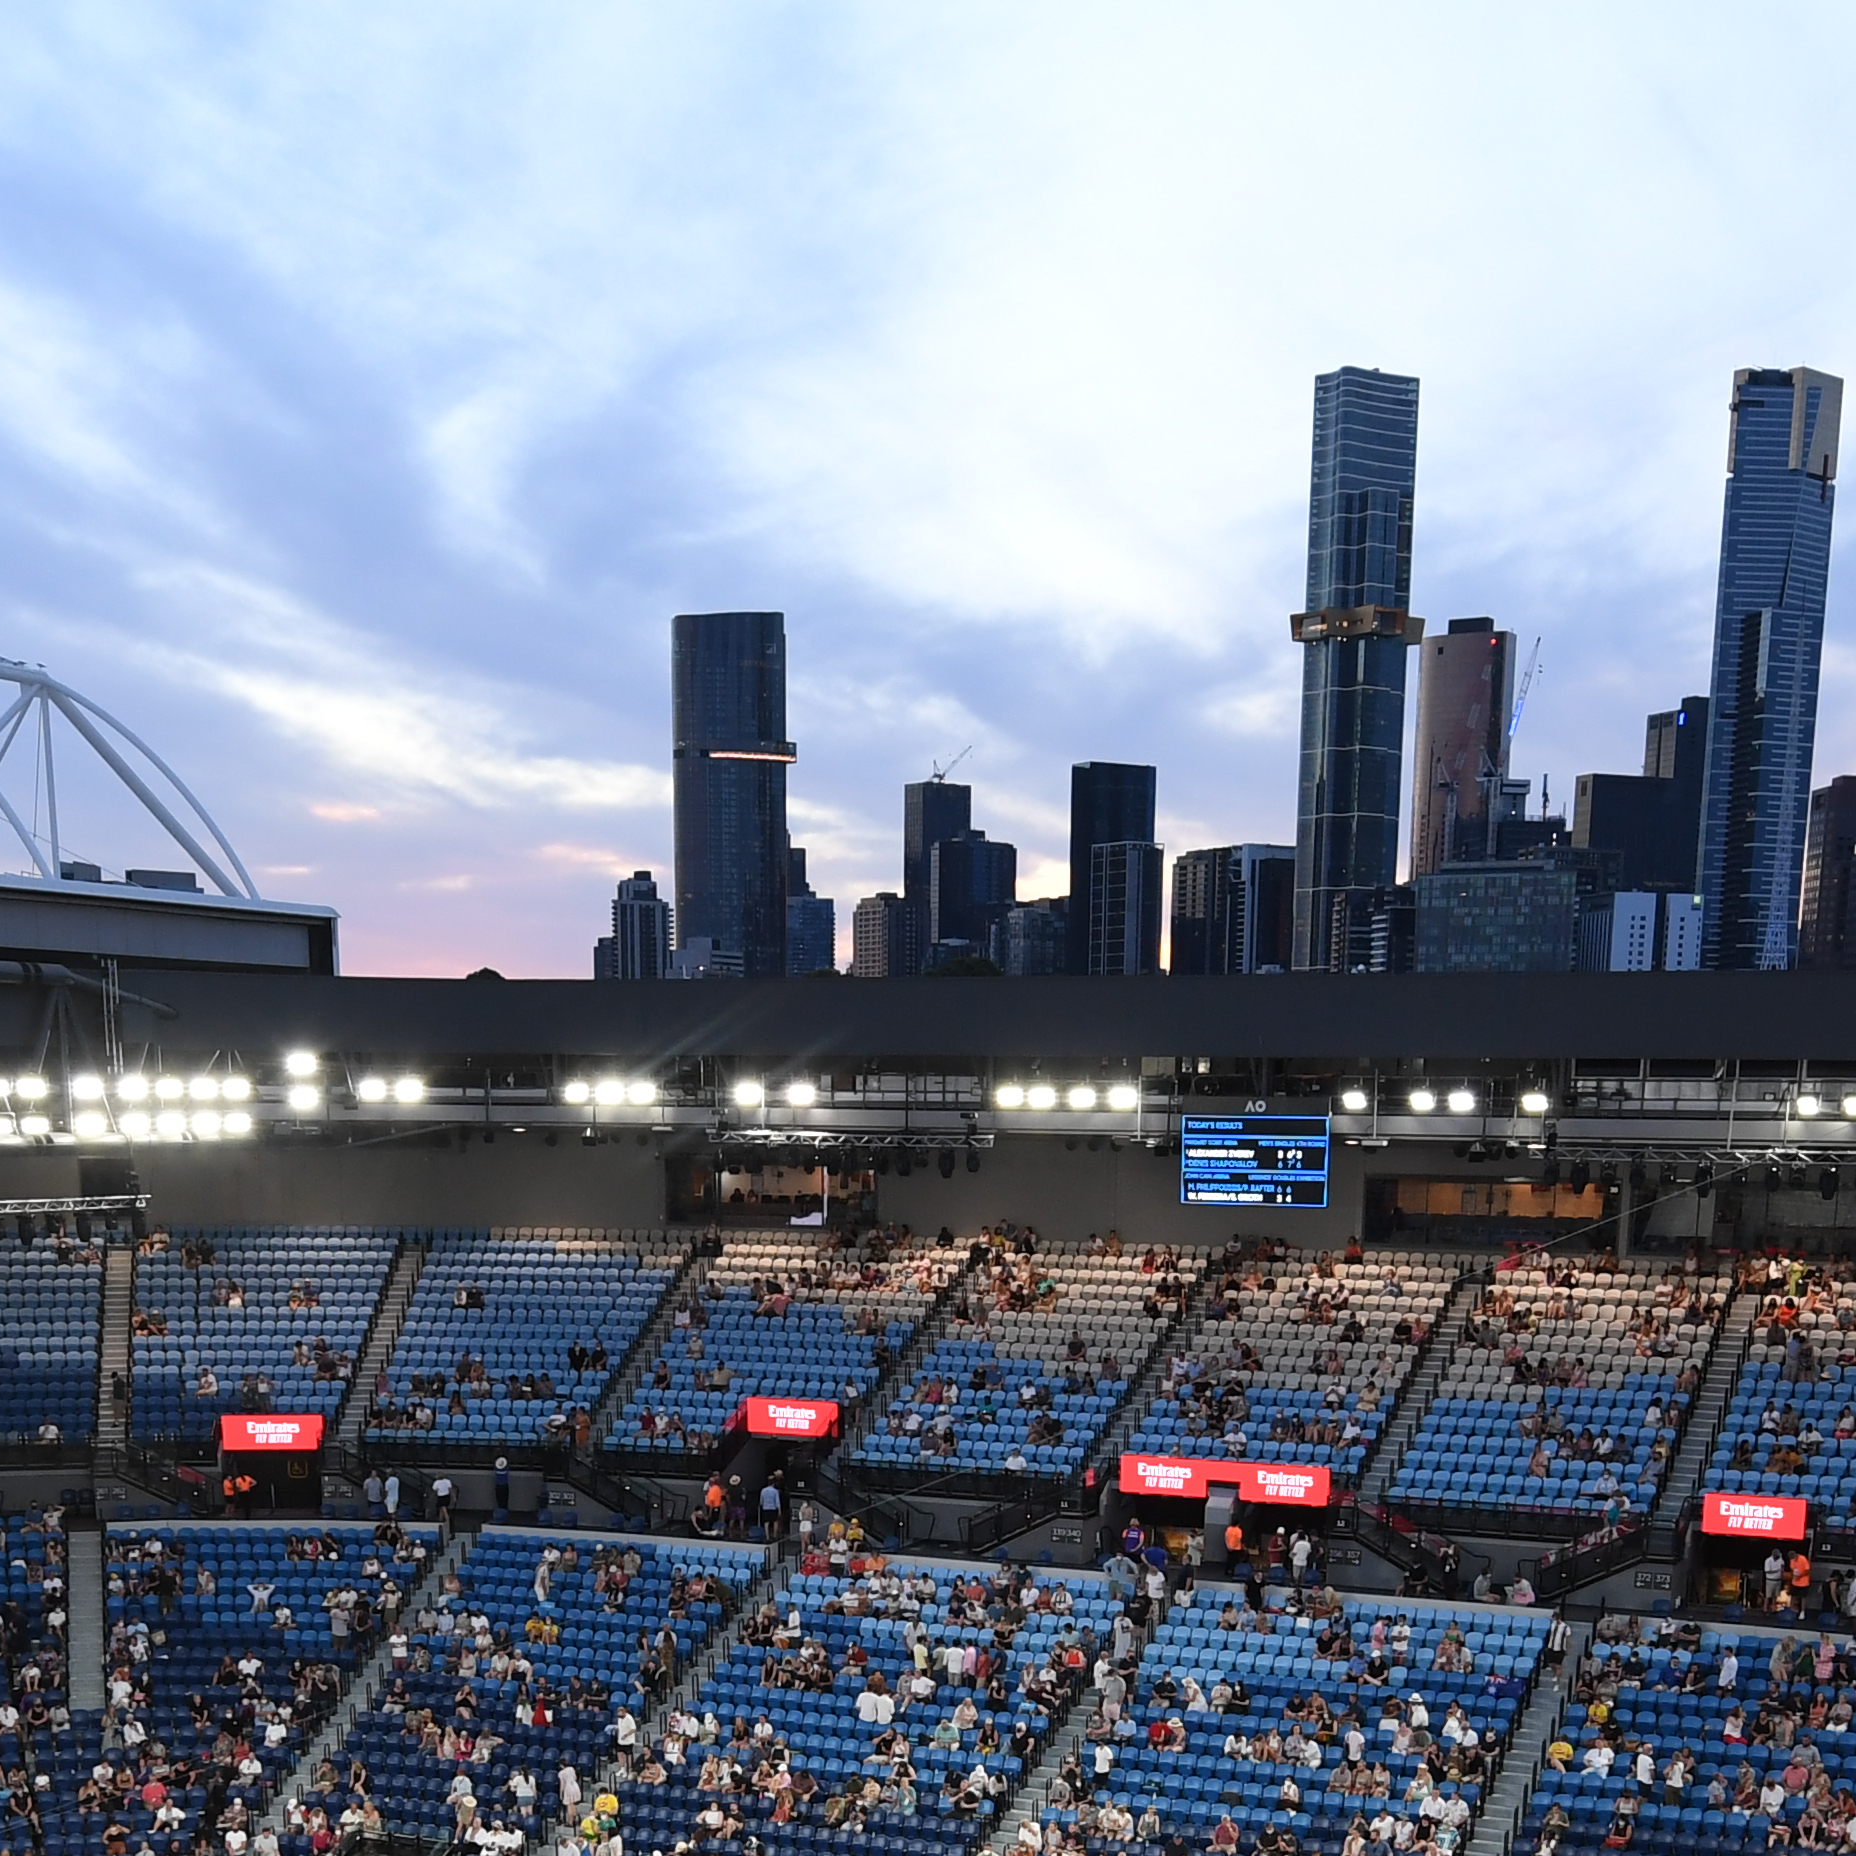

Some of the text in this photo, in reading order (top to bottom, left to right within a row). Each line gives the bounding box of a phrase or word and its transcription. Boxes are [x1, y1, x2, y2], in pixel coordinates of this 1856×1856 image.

[1244, 1100, 1267, 1113] AO
[768, 1404, 817, 1420] Emirates
[246, 1421, 300, 1434] Emirates
[776, 1418, 810, 1430] FLY BETTER
[255, 1434, 293, 1444] FLY BETTER
[1137, 1462, 1192, 1479] Emirates
[1144, 1477, 1184, 1490] FLY BETTER
[1257, 1471, 1314, 1488] Emirates
[1265, 1485, 1306, 1498] FLY BETTER
[1720, 1501, 1784, 1520] Emirates
[1728, 1517, 1774, 1531] FLY BETTER
[1636, 1574, 1671, 1583] 372 373
